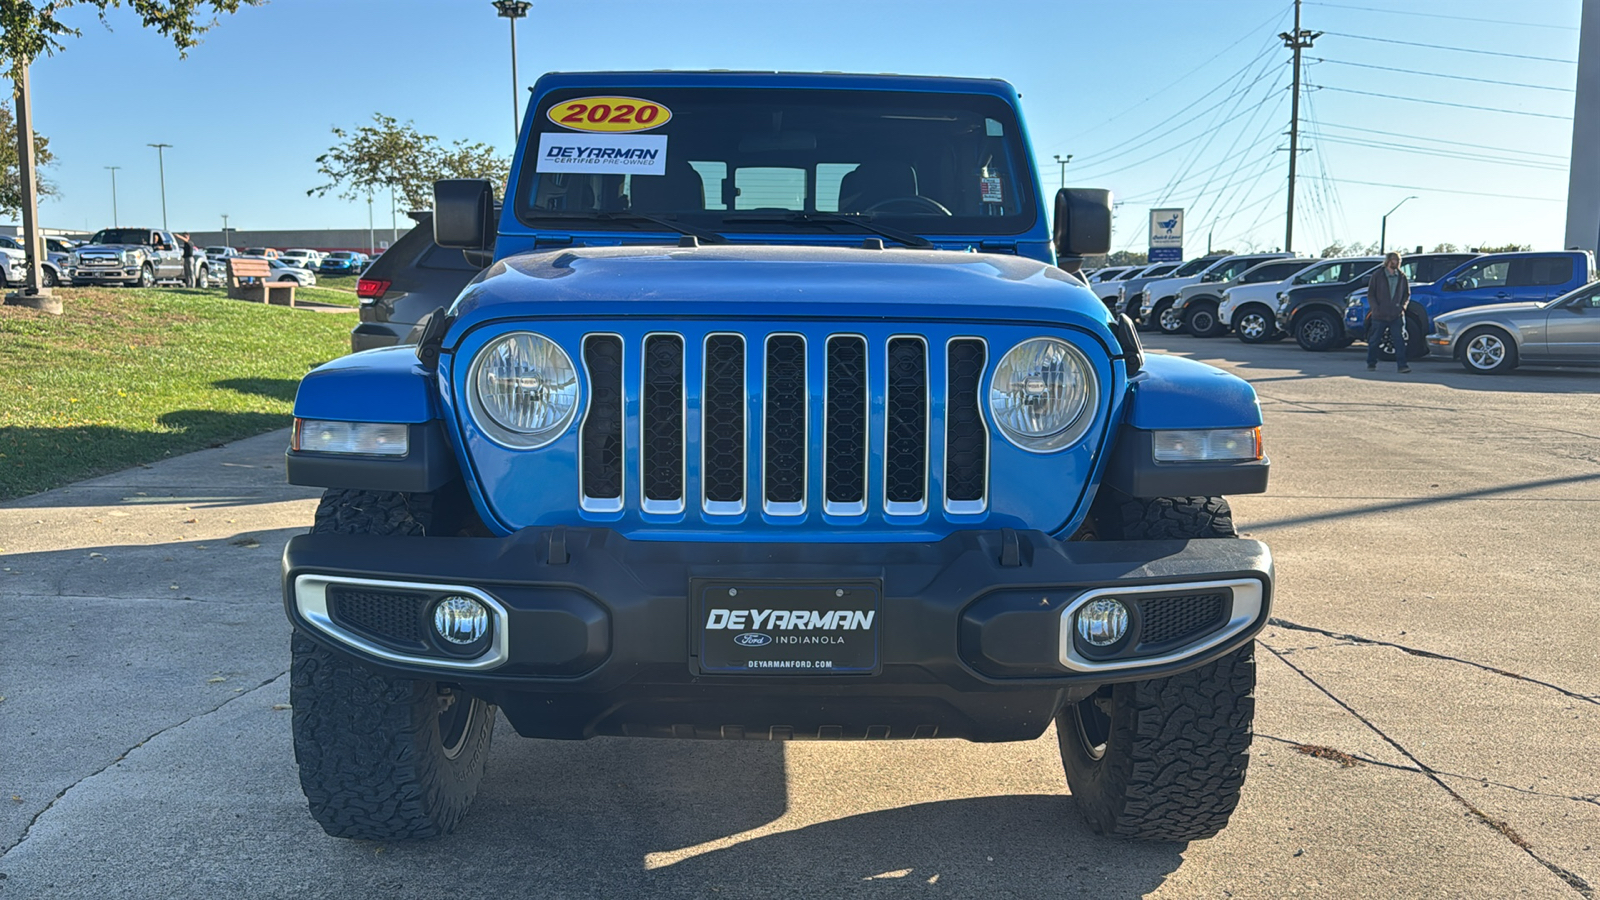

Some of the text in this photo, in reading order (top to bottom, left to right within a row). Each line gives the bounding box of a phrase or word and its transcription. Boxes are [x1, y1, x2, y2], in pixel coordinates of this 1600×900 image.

[560, 104, 659, 124] 2020
[546, 146, 659, 160] DEYARMAN
[705, 608, 875, 630] DEYARMAN
[741, 634, 845, 644] Ford INDIANOLA
[748, 660, 833, 668] DEYARMANFORD.COM
